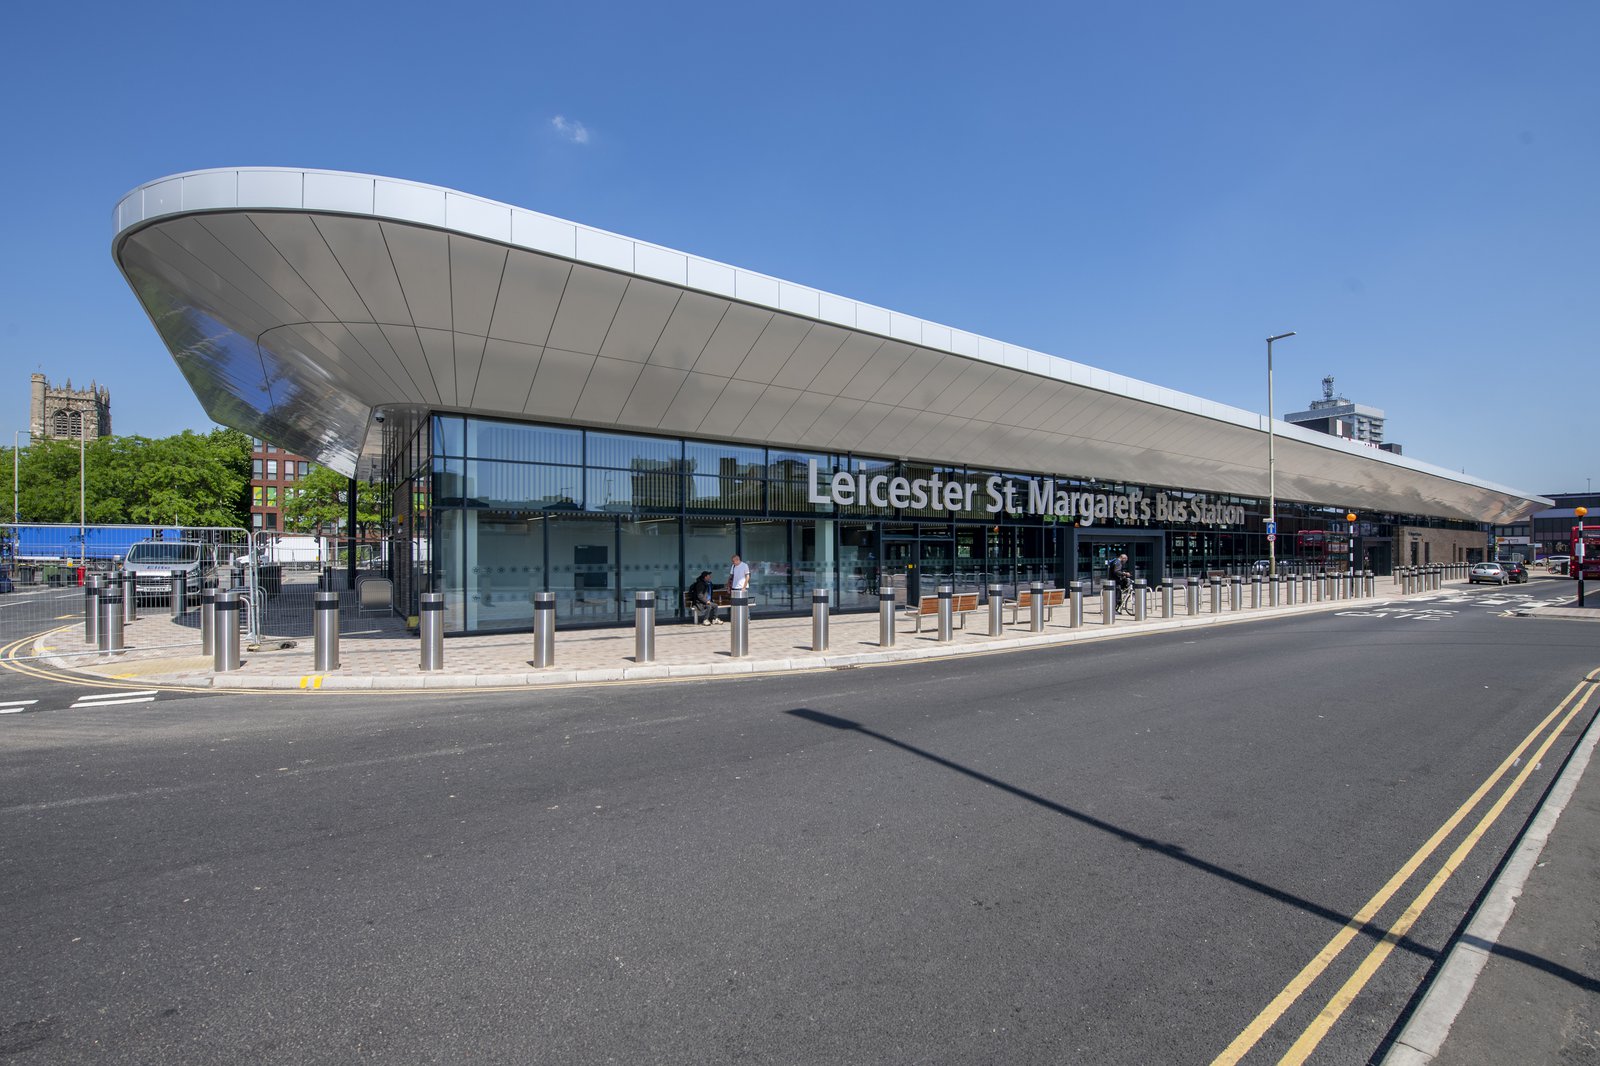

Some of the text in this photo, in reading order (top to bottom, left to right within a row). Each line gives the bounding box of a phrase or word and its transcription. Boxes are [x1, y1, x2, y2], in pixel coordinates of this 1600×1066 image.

[808, 458, 1245, 527] Leicester St. Margaret's Bus Station
